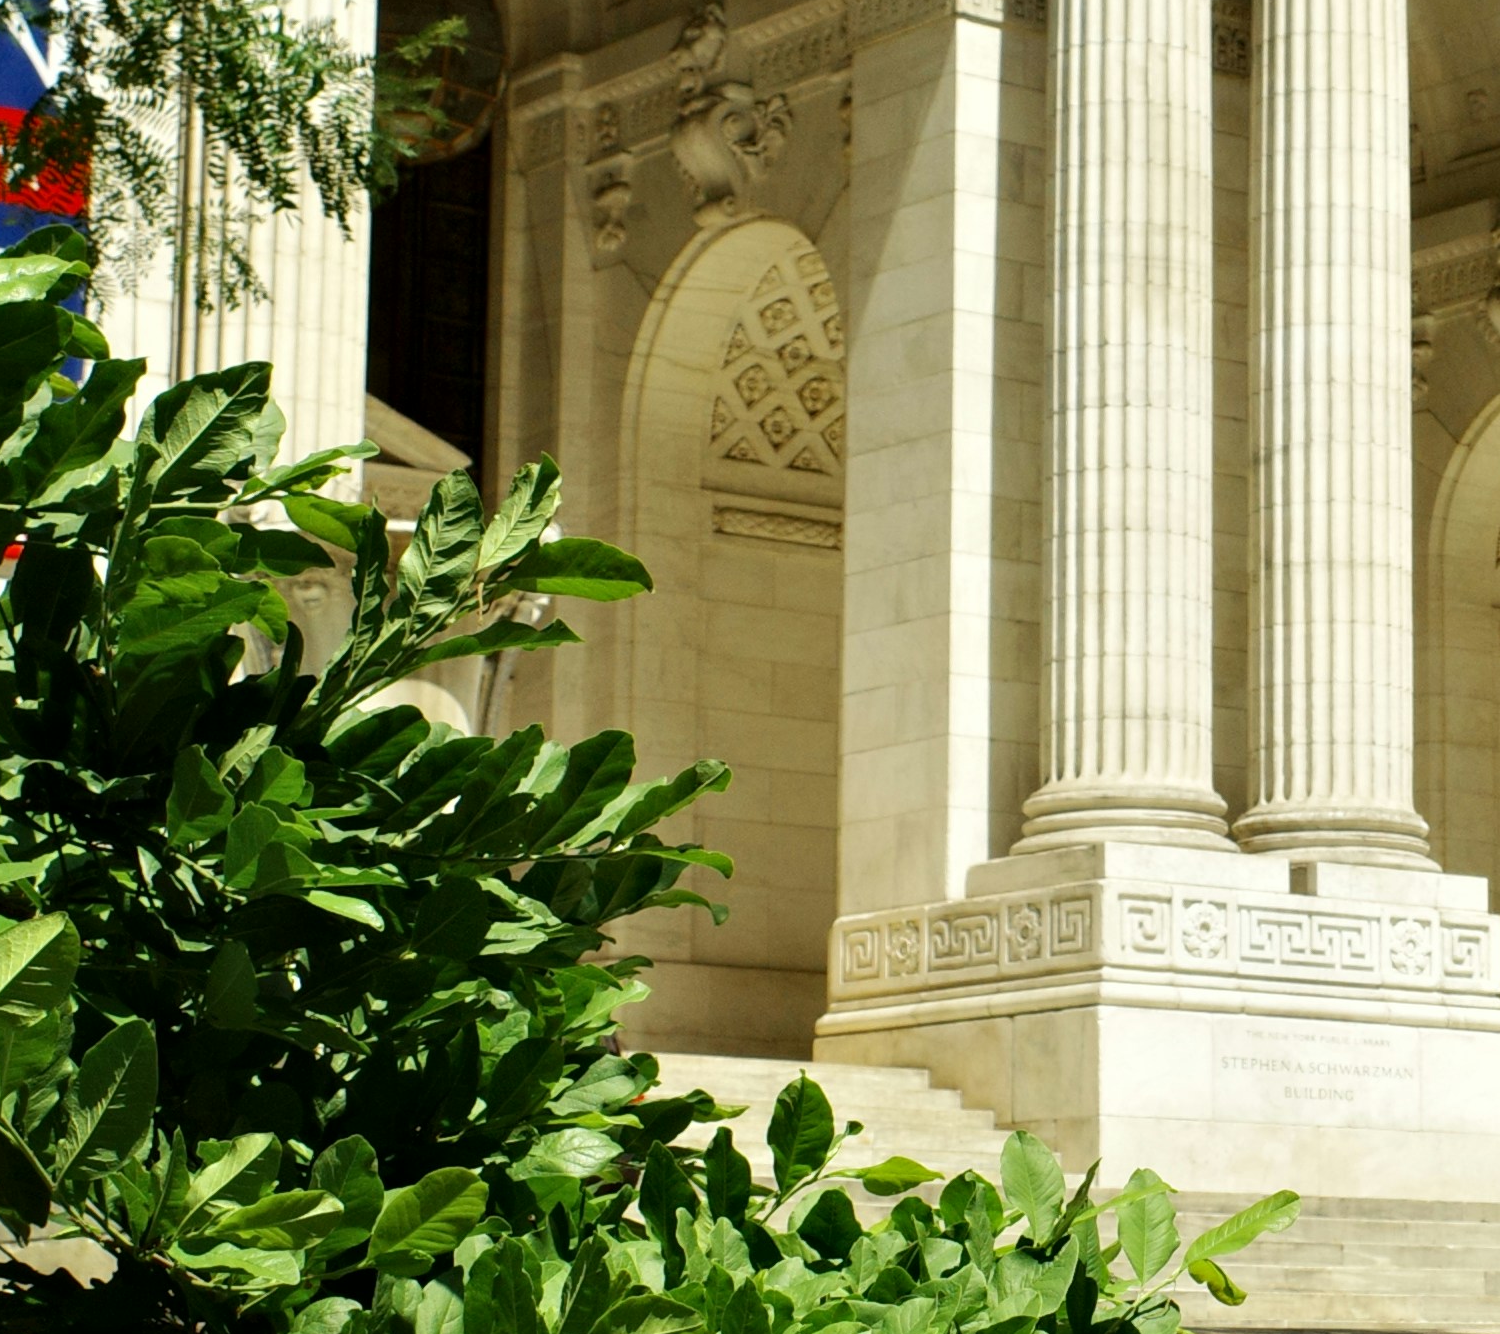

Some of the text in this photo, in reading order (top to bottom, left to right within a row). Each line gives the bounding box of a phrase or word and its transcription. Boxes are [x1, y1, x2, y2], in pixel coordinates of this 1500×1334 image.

[1220, 1055, 1291, 1073] STEPHEN
[1308, 1061, 1415, 1080] SCHWARZMAN
[1283, 1085, 1355, 1102] BUILDING
